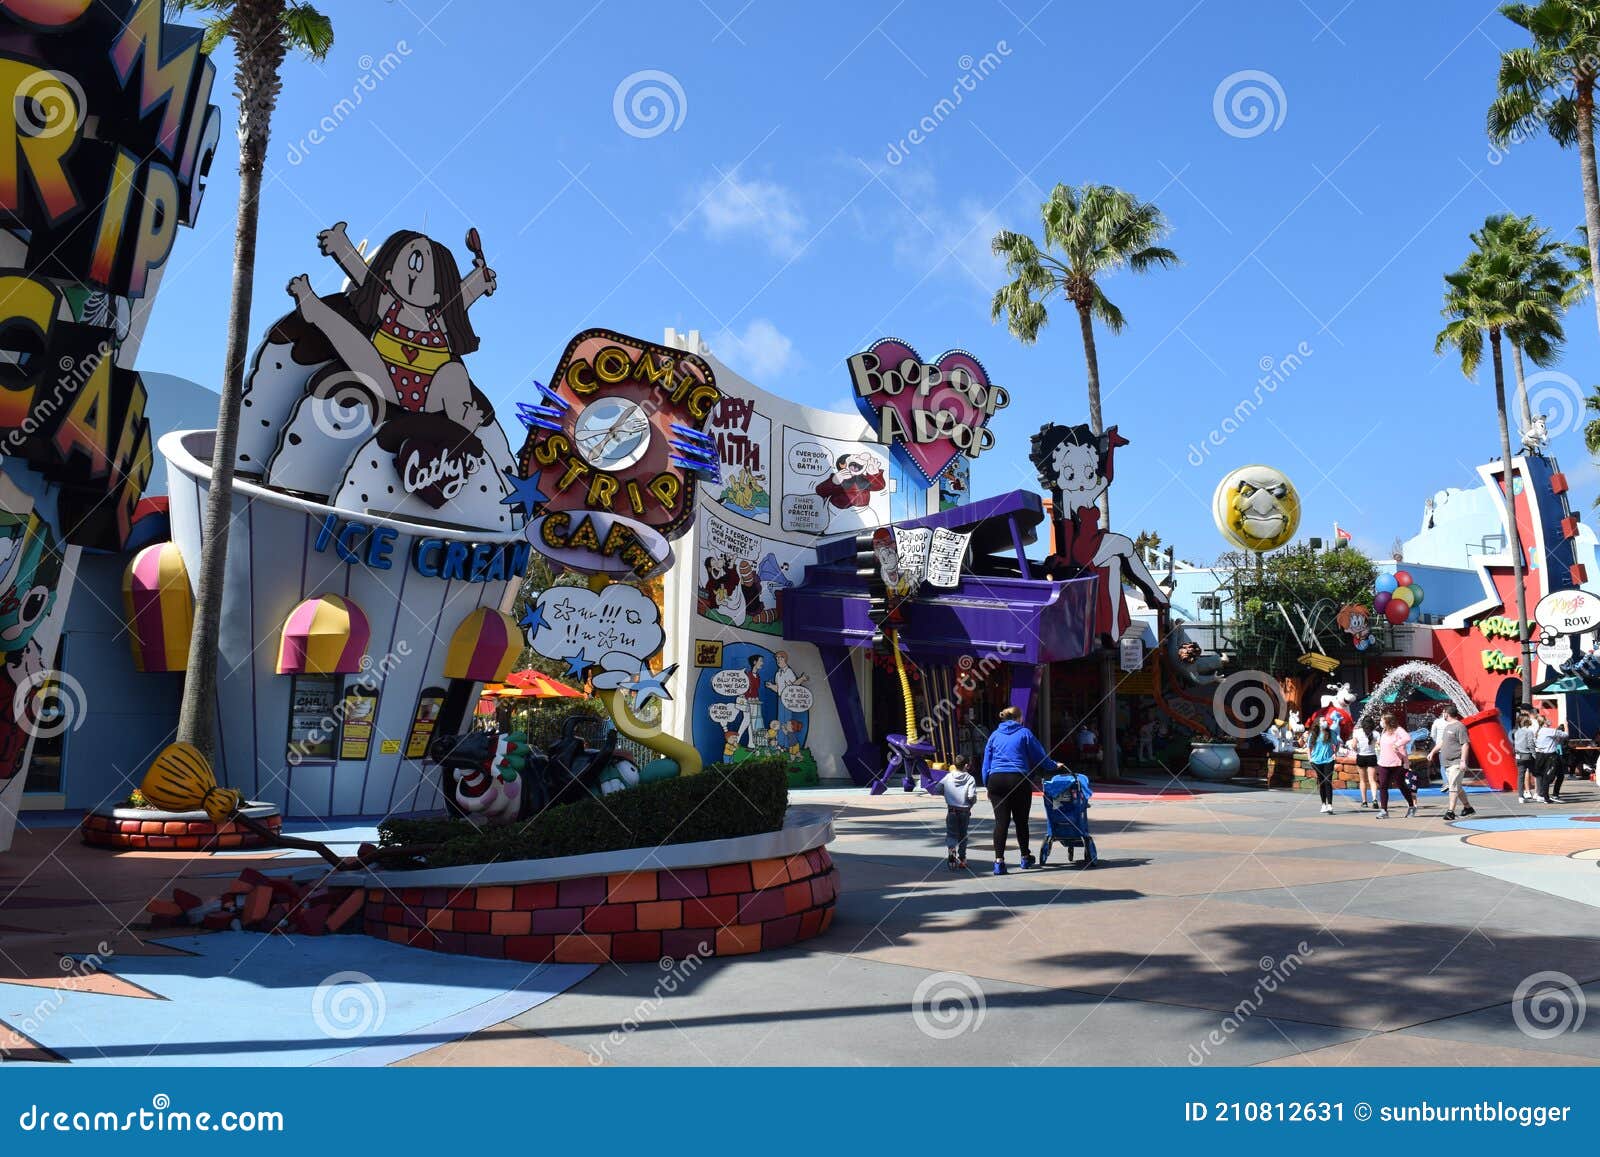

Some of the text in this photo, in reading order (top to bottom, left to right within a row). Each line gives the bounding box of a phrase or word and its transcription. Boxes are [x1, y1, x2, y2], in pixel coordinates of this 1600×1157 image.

[0, 0, 221, 229] MIC
[565, 345, 722, 421] COMIC
[950, 367, 1011, 416] OOP
[878, 406, 996, 458] A DOOP
[403, 448, 481, 500] Cathy's
[534, 433, 681, 515] STRIP
[315, 512, 531, 583] ICE CREAM
[1564, 616, 1592, 628] ROW
[1480, 649, 1519, 676] KAT
